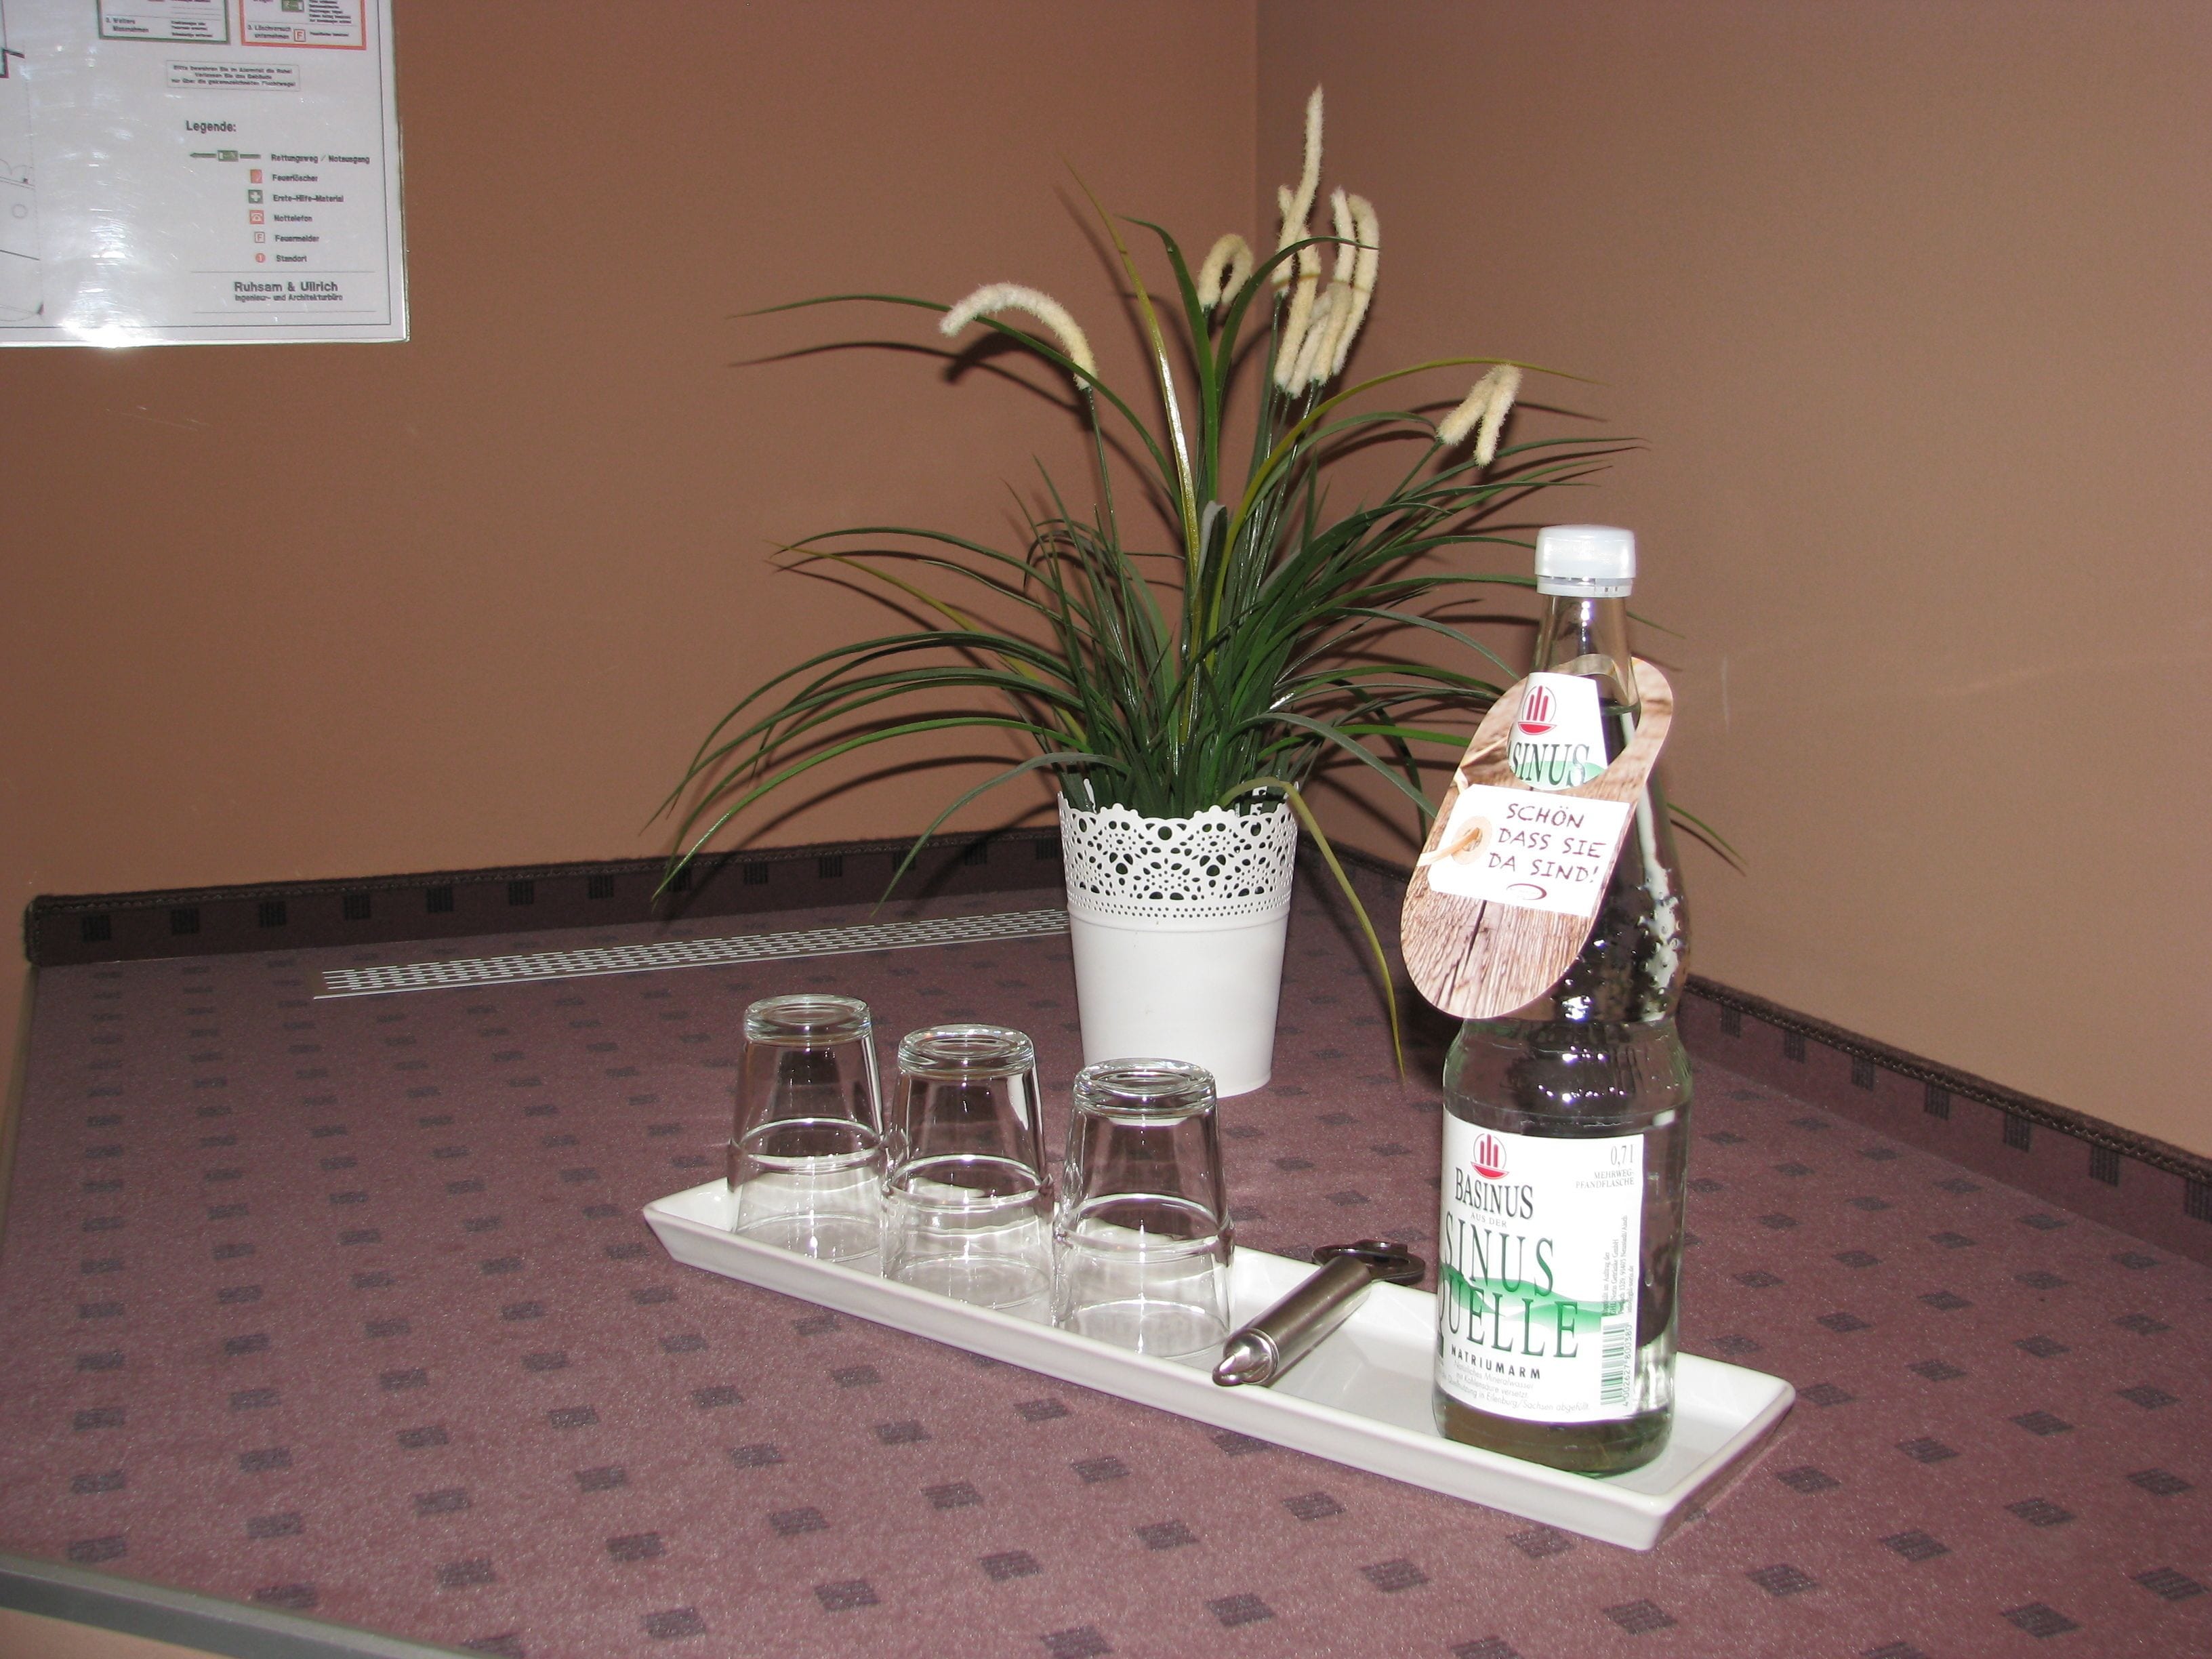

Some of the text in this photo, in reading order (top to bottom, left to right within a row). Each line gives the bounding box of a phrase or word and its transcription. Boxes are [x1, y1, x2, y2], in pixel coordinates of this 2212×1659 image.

[186, 120, 237, 134] Legende:
[271, 154, 319, 163] Rettungsweg
[328, 155, 370, 165] Notausgang
[272, 173, 318, 182] Feuerlöscher
[273, 194, 344, 203] Erste-Hilfe-Material
[274, 214, 312, 222] Nottelefon
[275, 234, 320, 243] Feuermelder
[276, 254, 308, 263] Standort
[234, 281, 338, 292] Ruhsam & Ullrich
[235, 294, 271, 302] Ingenieur-
[1507, 803, 1584, 828] SCHÖN
[1498, 827, 1607, 858] DASS SIE
[1488, 853, 1599, 883] DA SIND!
[1576, 1177, 1634, 1189] PFANDFLASCHE
[1455, 1167, 1534, 1220] BASINUS
[1470, 1212, 1507, 1228] AUS DER
[1444, 1210, 1554, 1297] SINUS
[1624, 1325, 1633, 1359] 800380
[1451, 1343, 1540, 1380] NATRIUMARM
